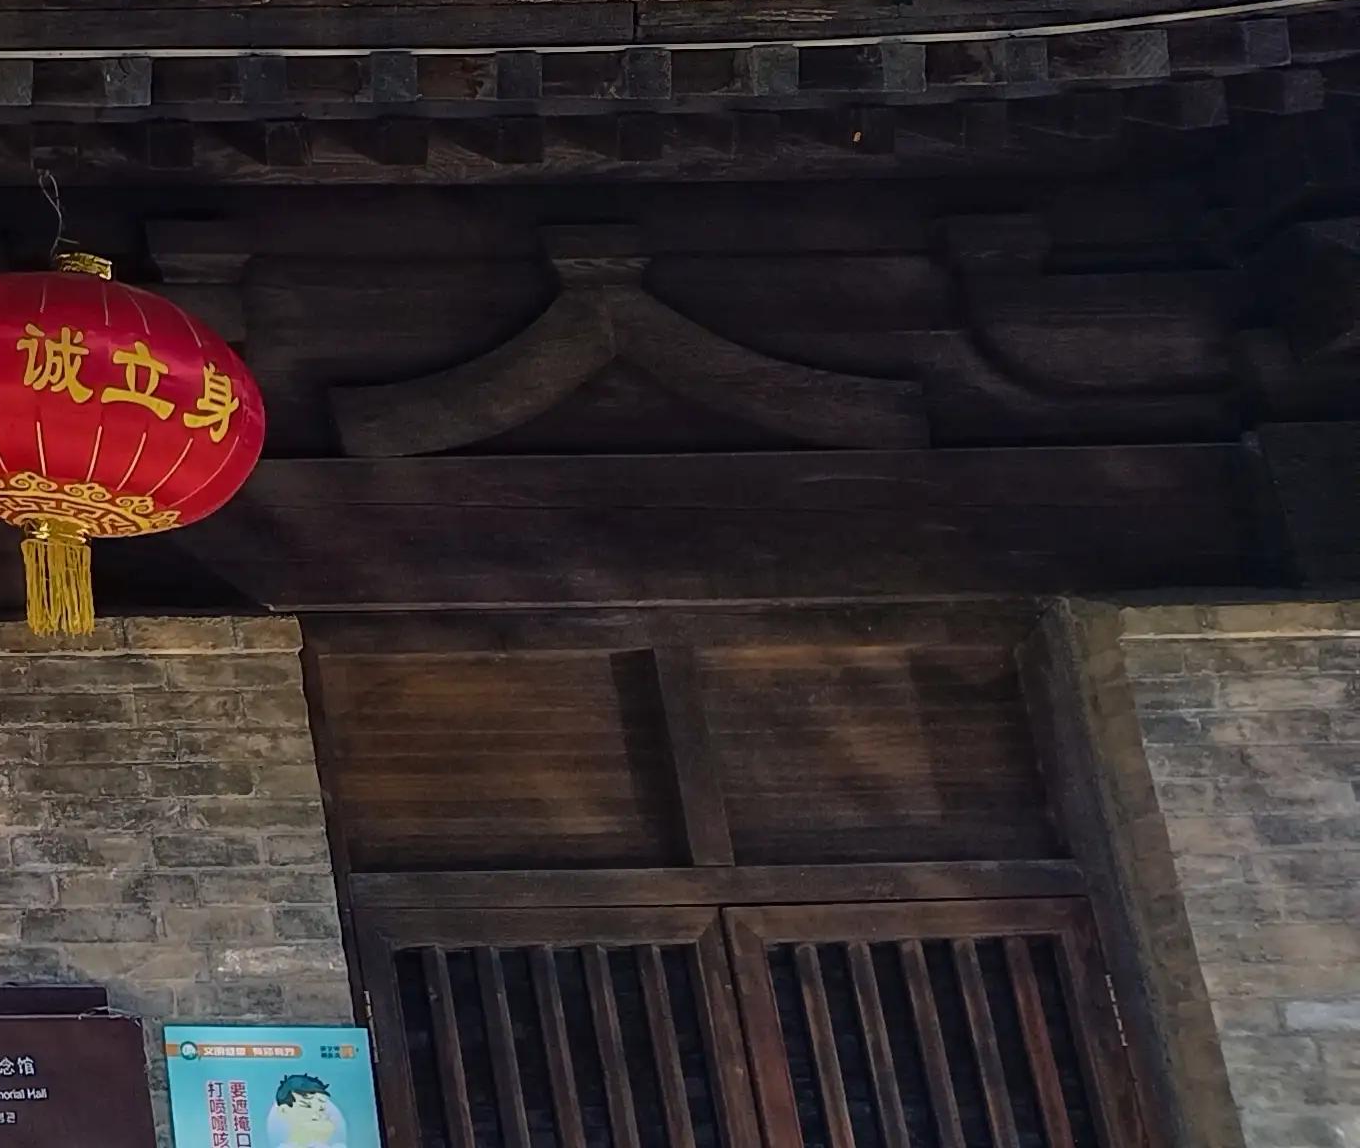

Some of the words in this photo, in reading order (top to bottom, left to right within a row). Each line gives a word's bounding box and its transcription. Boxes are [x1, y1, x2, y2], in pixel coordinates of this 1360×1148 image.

[17, 323, 240, 444] 诚立身
[26, 1088, 48, 1099] Hall
